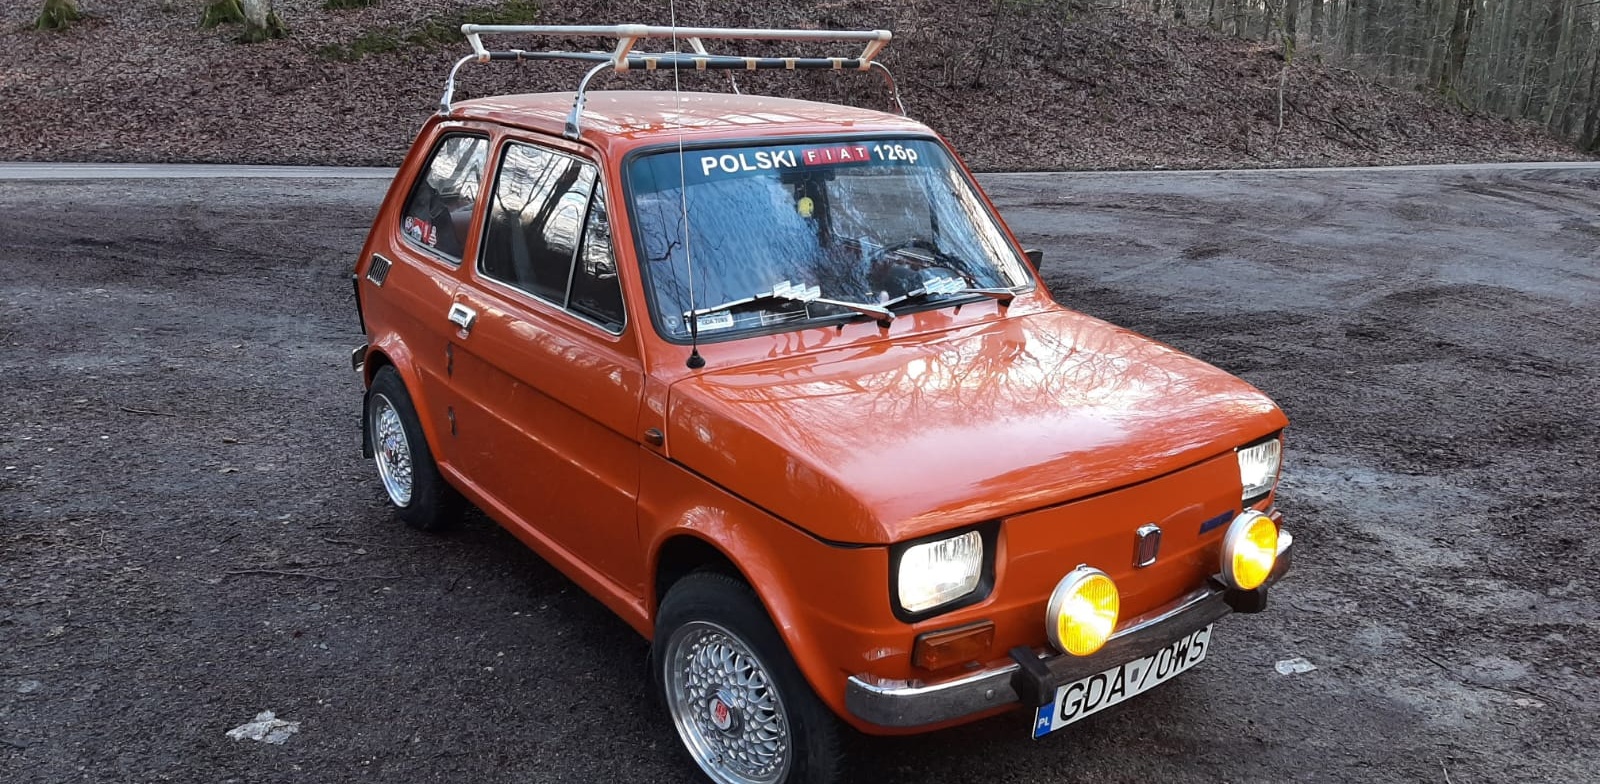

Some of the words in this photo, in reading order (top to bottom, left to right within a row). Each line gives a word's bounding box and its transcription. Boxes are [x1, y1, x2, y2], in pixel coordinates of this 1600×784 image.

[701, 150, 797, 176] POLSKI
[807, 147, 865, 163] FIAT
[873, 144, 918, 164] 126p
[1060, 665, 1126, 721] GDA
[1138, 627, 1208, 690] 70WS
[1037, 717, 1050, 729] PL
